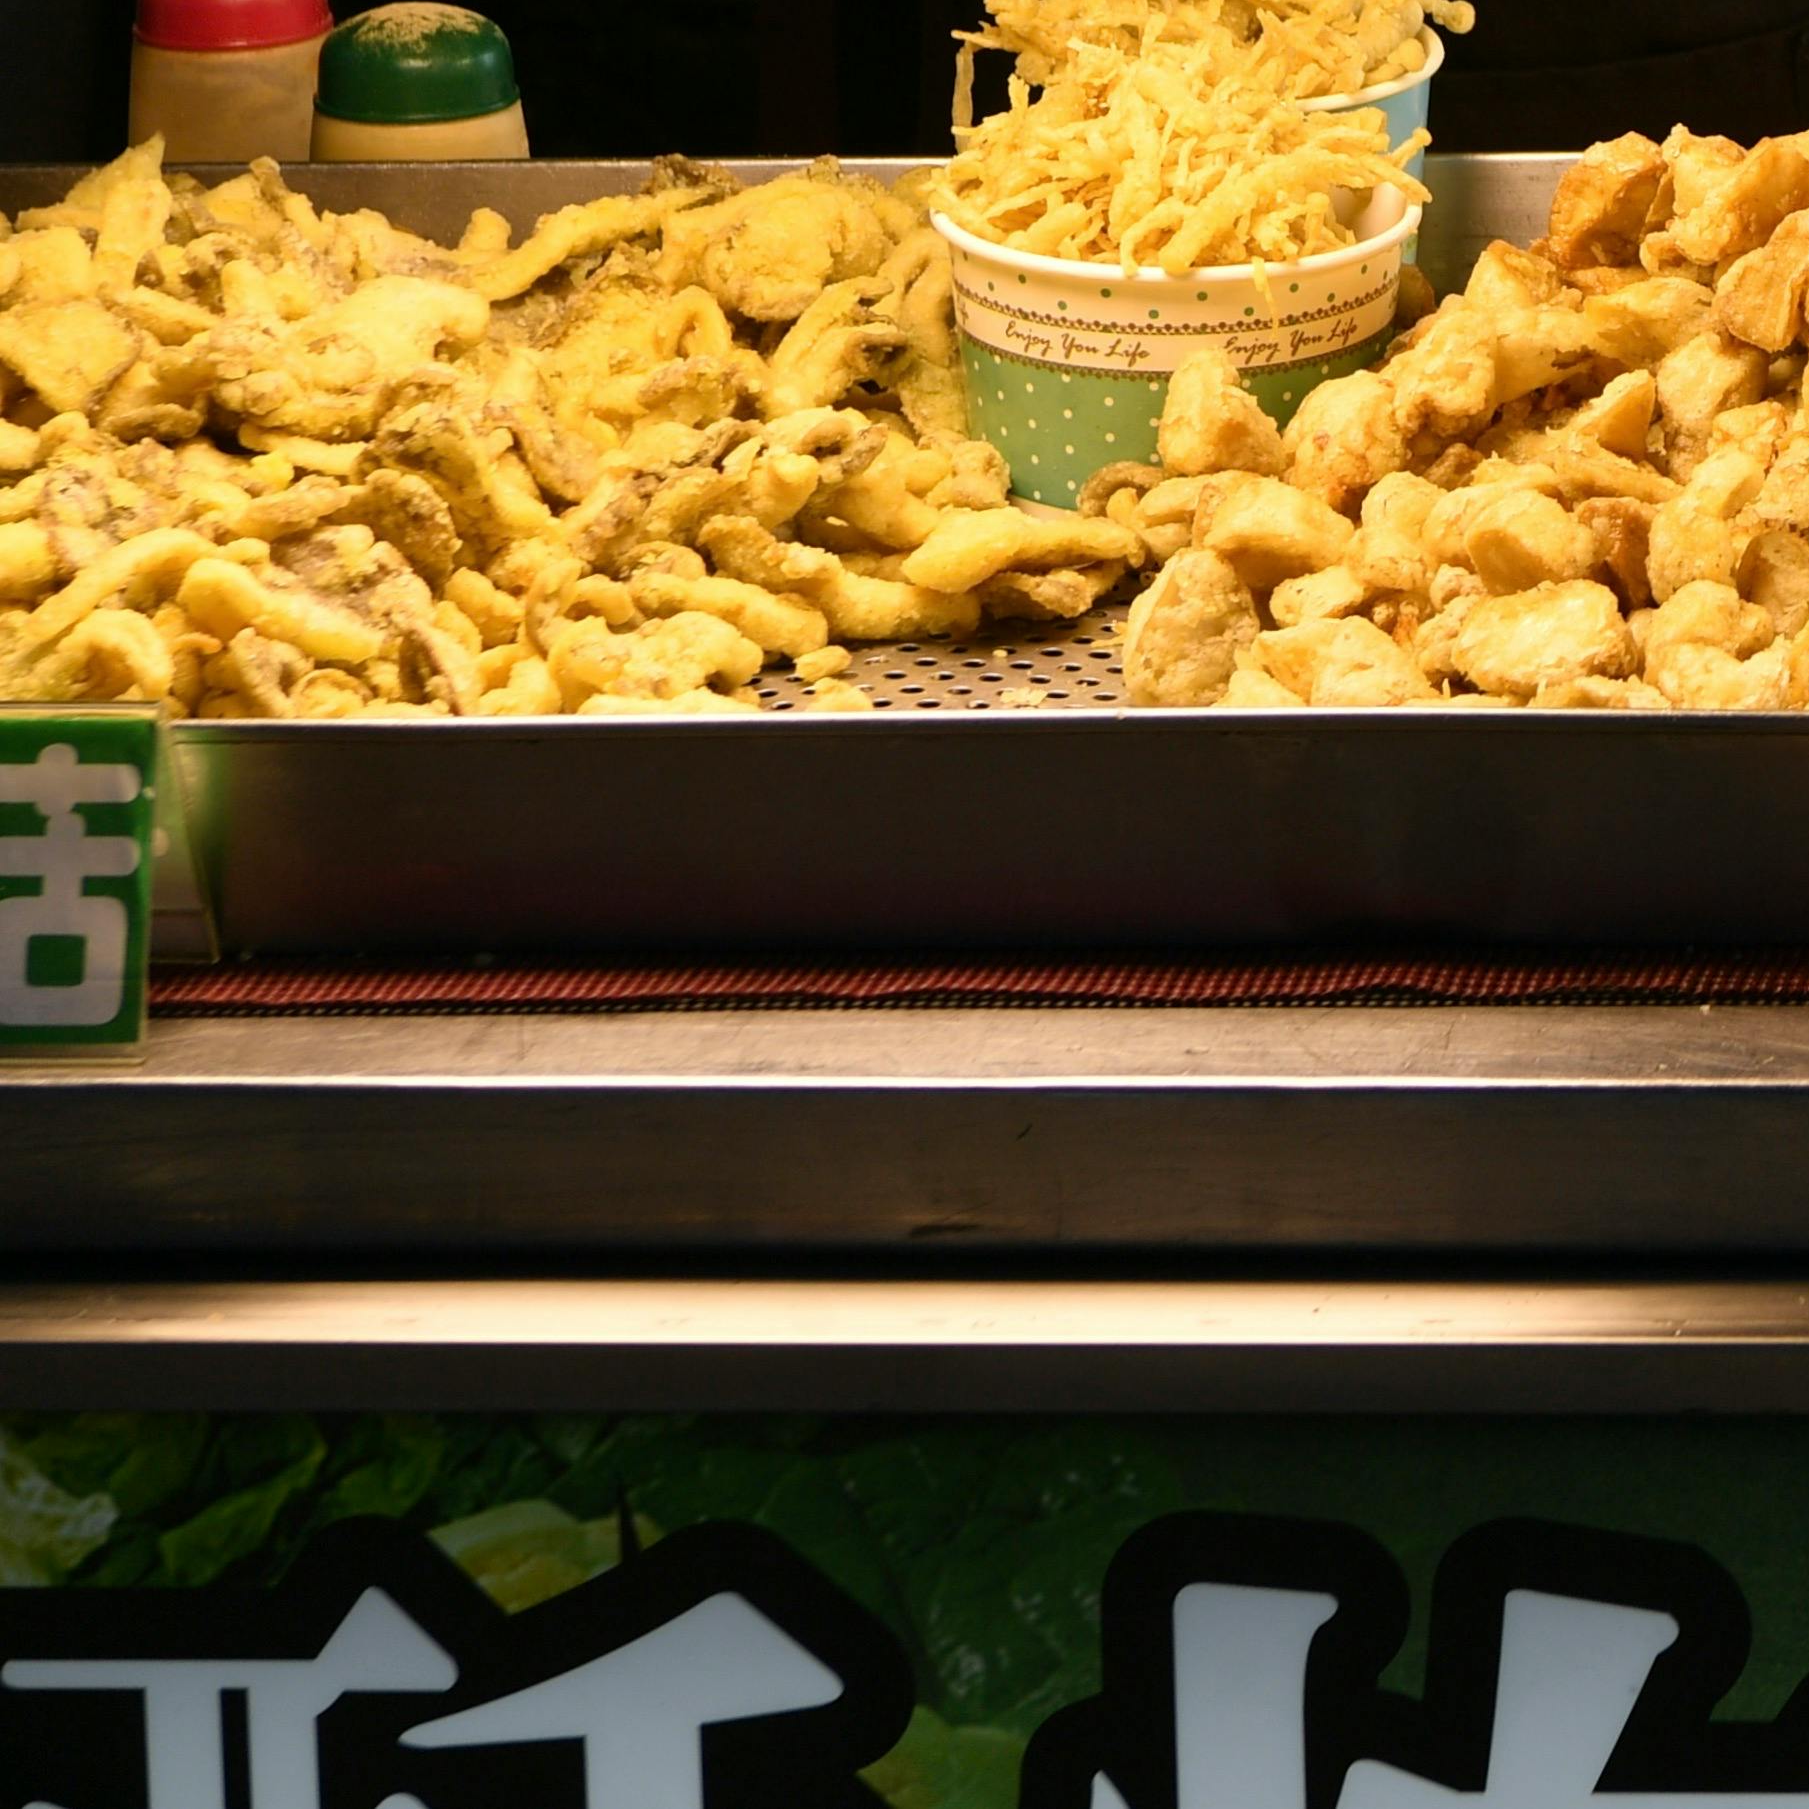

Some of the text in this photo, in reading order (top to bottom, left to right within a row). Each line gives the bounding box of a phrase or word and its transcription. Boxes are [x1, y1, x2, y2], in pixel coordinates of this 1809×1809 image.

[1006, 320, 1150, 367] Enjoy You Life
[1223, 316, 1358, 365] Enjoy You Life
